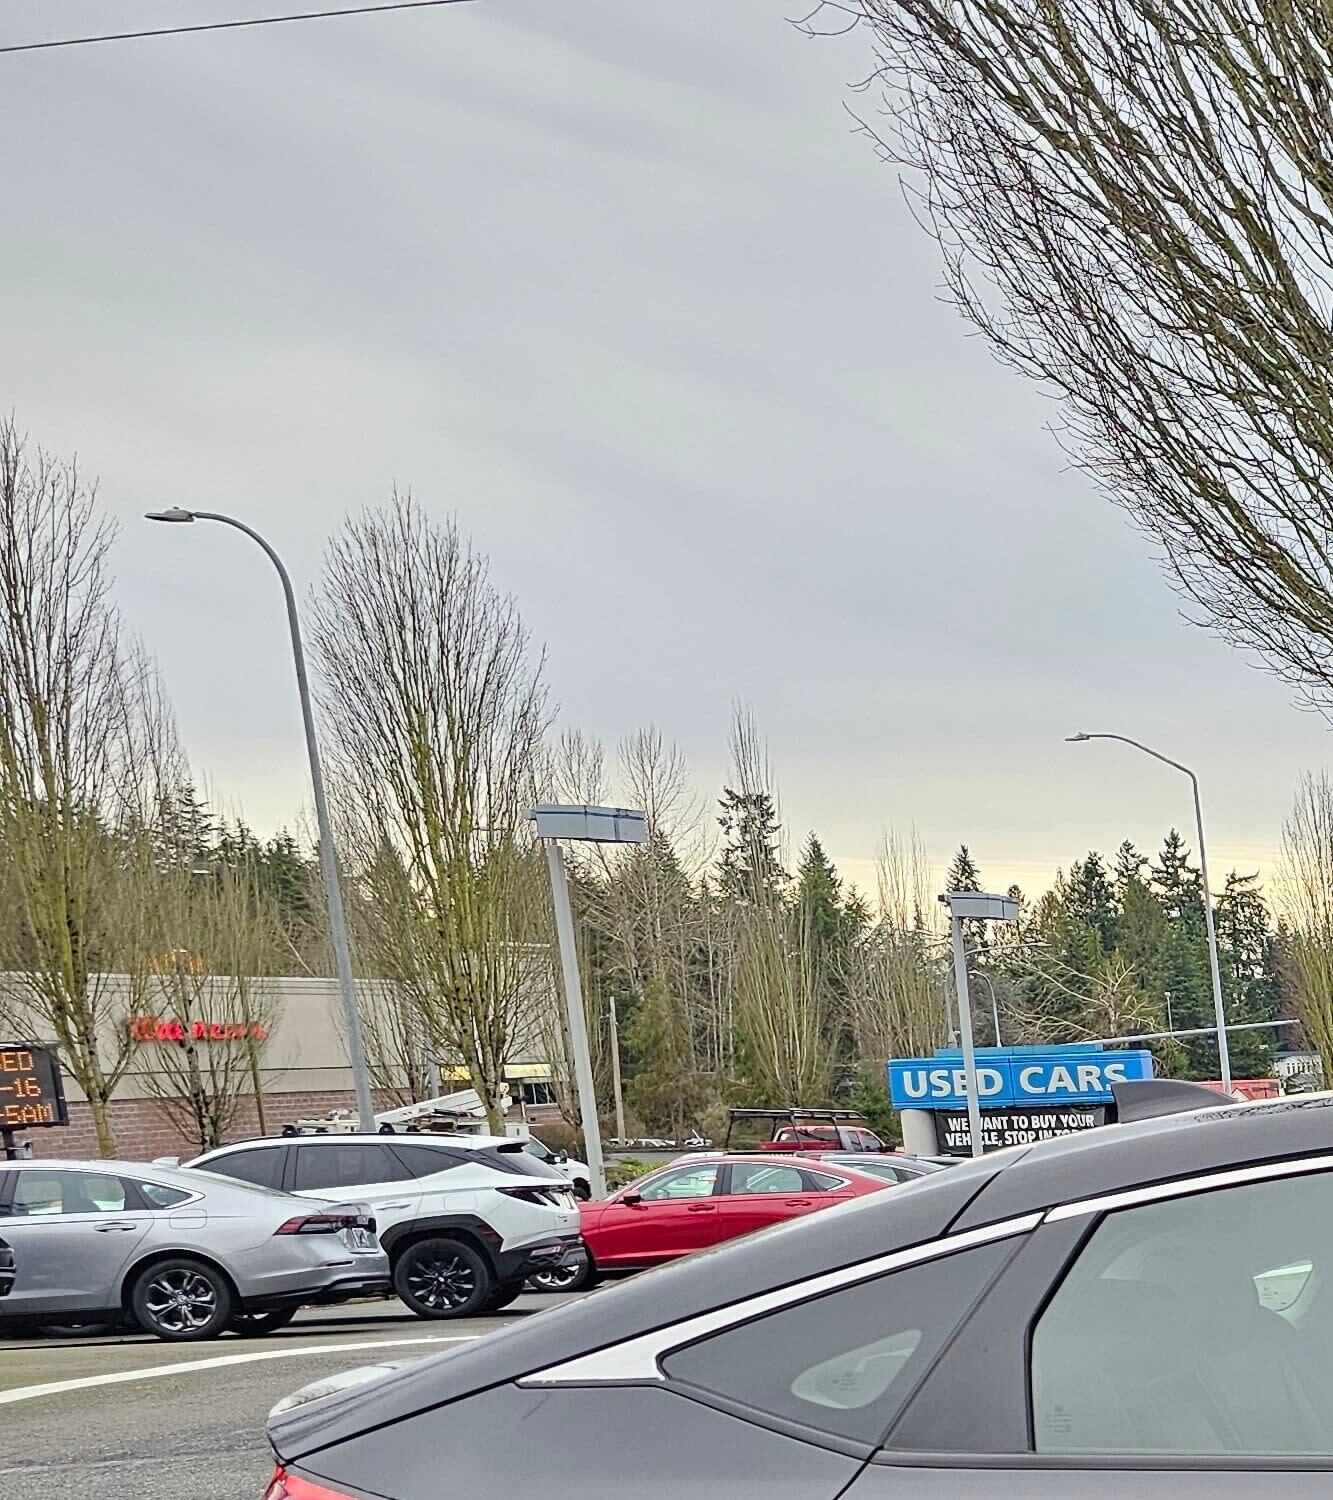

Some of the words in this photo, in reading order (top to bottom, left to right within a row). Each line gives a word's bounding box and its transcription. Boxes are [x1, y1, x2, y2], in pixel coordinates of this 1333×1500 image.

[0, 1051, 34, 1071] ED
[902, 1068, 1004, 1098] USED
[1019, 1063, 1128, 1094] CARS
[947, 1117, 969, 1131] WE
[976, 1116, 1008, 1130] ANT
[1011, 1115, 1028, 1129] TO
[1031, 1114, 1056, 1129] BUY
[1059, 1114, 1095, 1128] YOUR
[1004, 1130, 1036, 1145] STOP
